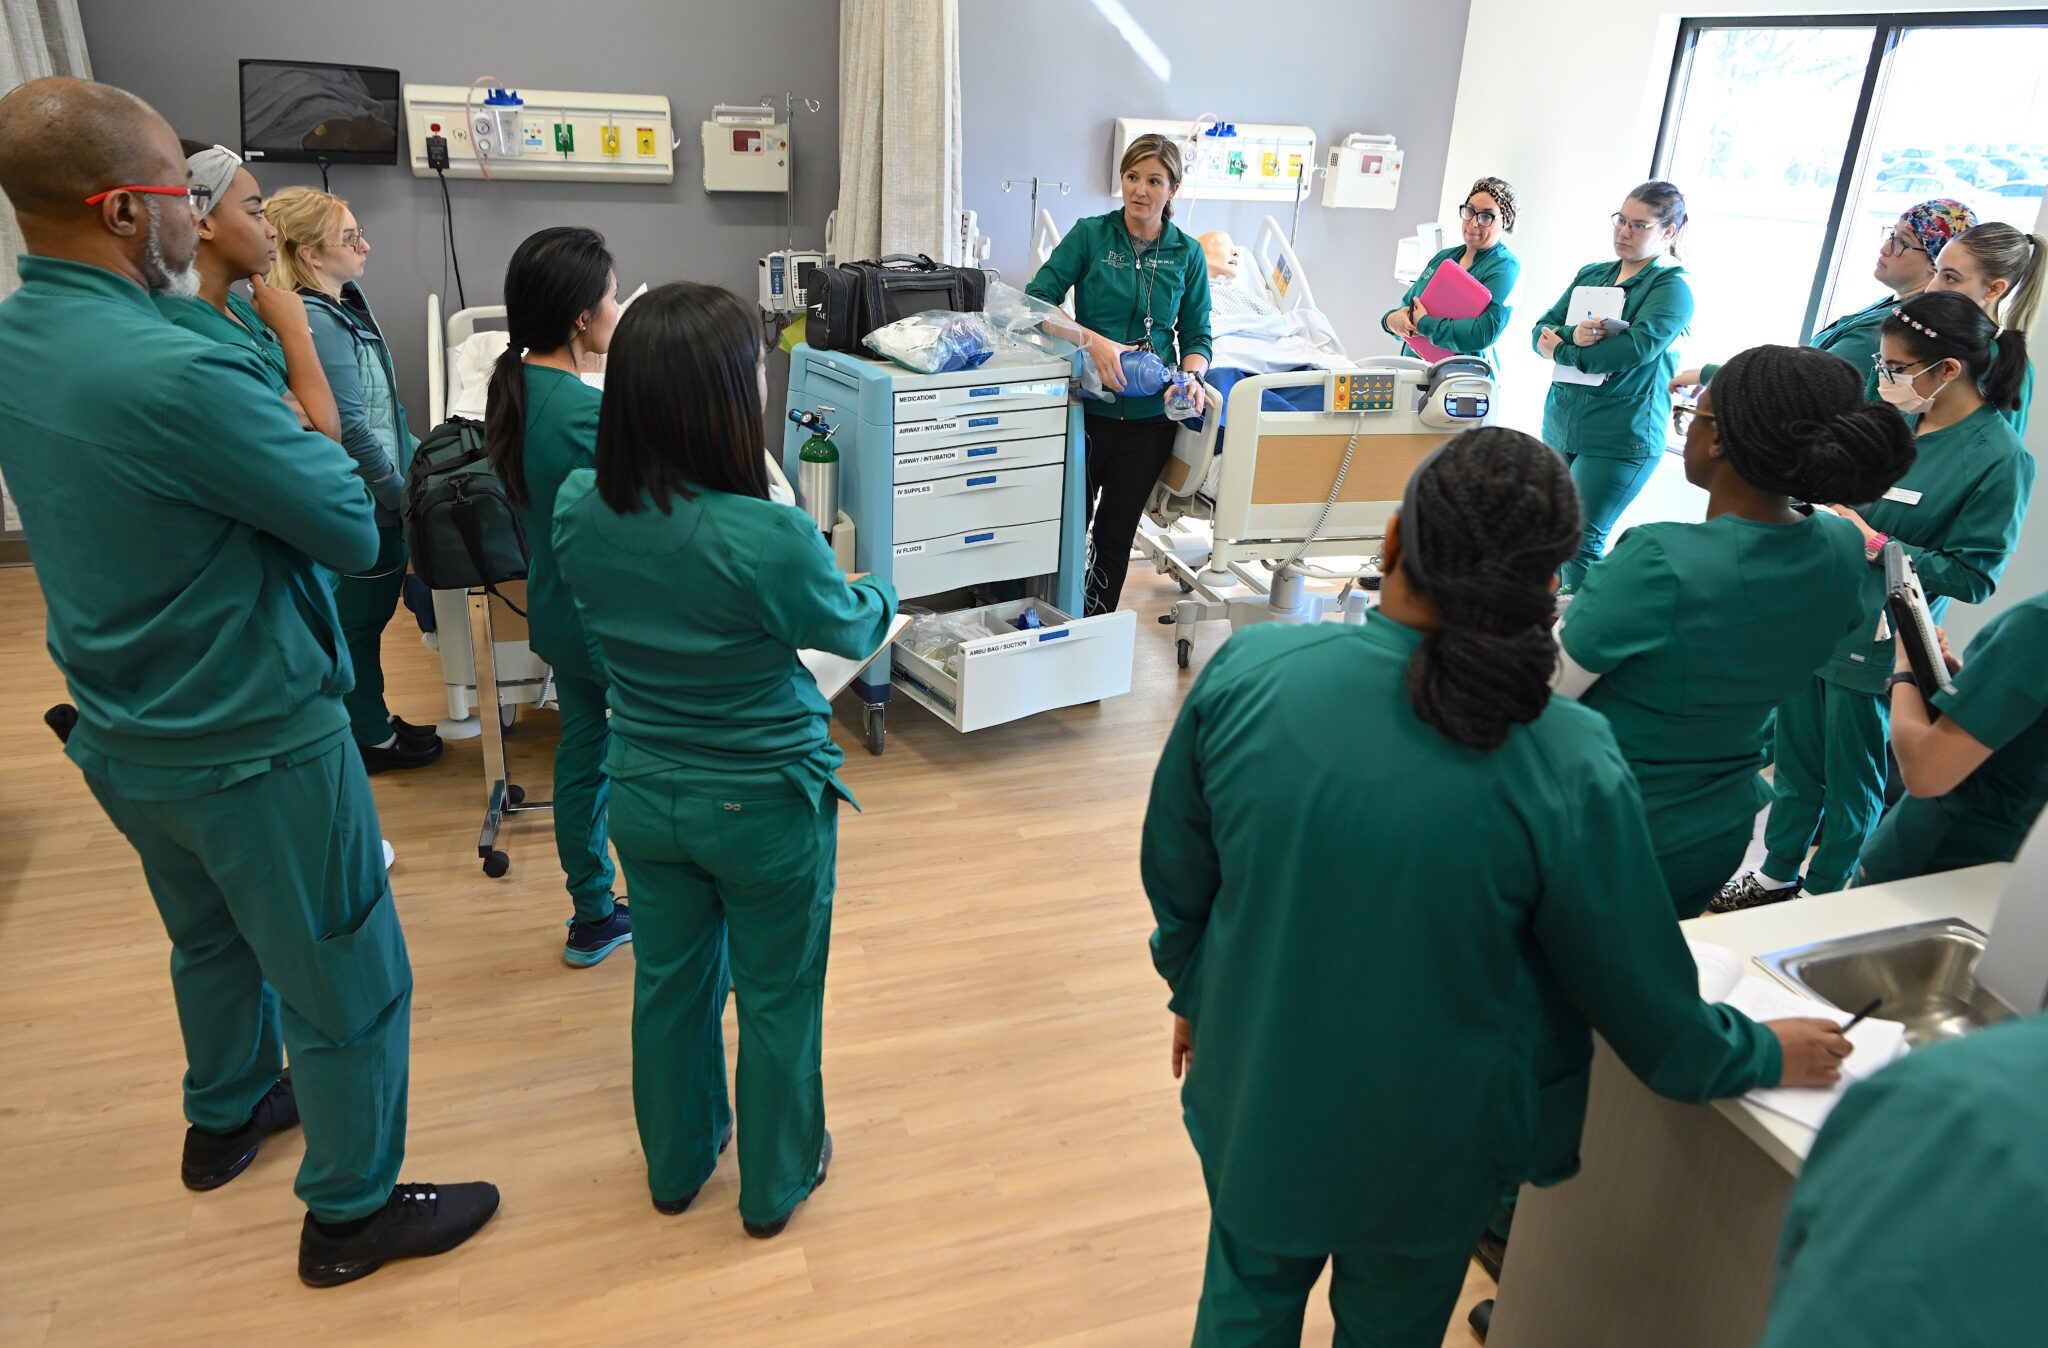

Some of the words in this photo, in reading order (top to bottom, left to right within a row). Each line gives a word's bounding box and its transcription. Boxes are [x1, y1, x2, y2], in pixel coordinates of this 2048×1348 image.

[815, 311, 827, 320] CAE
[899, 394, 937, 403] MEDICATIONS
[924, 422, 957, 431] INTUBATION
[898, 457, 920, 465] AIRWAY
[923, 452, 956, 462] INTUBATION
[904, 486, 931, 495] SUPPLIES
[903, 545, 922, 554] FLUIDS
[970, 648, 986, 656] AMBU
[987, 645, 1000, 653] BAG
[1003, 640, 1027, 650] SUCTION
